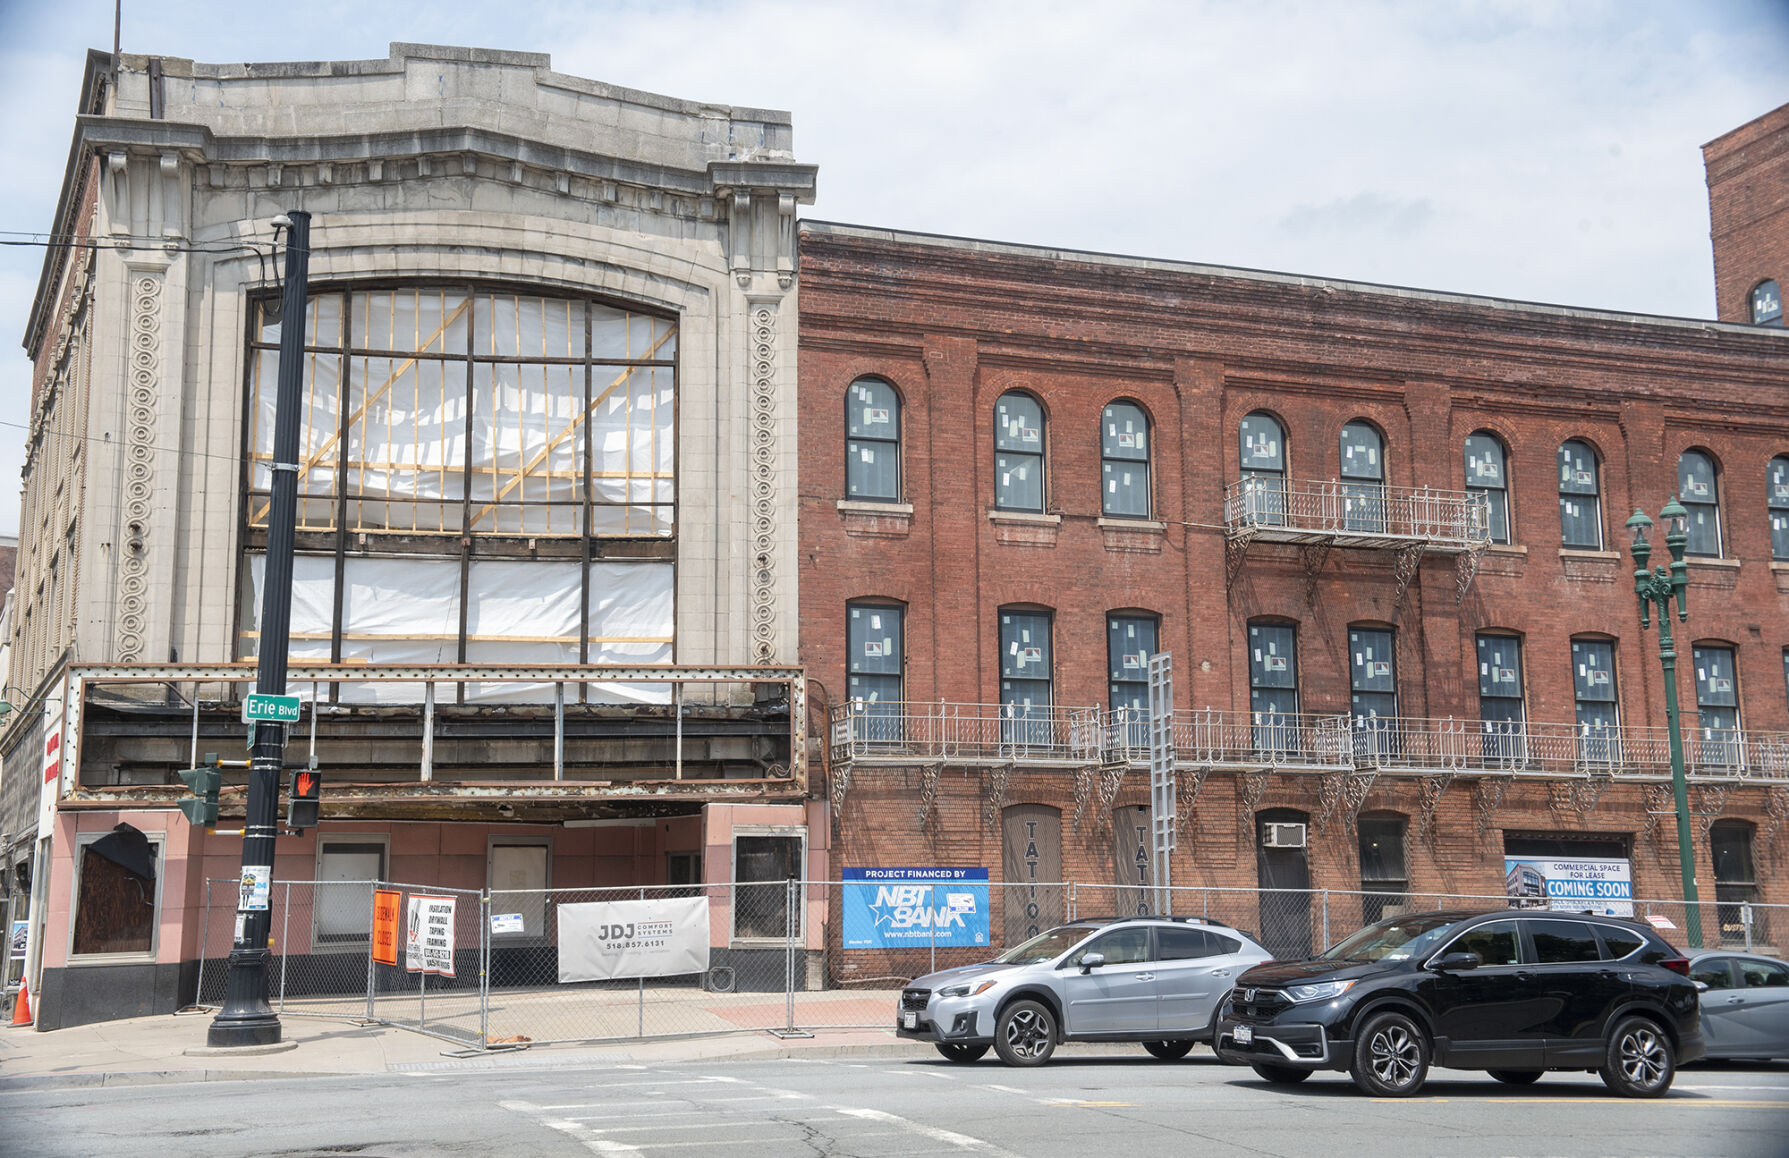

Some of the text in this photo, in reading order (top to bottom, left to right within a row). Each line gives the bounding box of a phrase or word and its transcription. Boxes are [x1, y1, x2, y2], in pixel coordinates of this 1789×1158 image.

[249, 699, 298, 717] Erie Blvd
[865, 870, 966, 878] PROJECT FINANCED BY
[1135, 826, 1149, 916] TATTO
[1553, 863, 1621, 872] COMMERCIAL SPACE
[1025, 820, 1040, 940] TATTOO
[1570, 871, 1584, 879] FOR
[1547, 881, 1630, 897] COMING SOON
[875, 885, 933, 907] NBT
[428, 915, 448, 925] DRYWALL
[890, 906, 966, 928] BANK
[429, 926, 445, 936] TAPING
[598, 923, 635, 941] JDJ
[1723, 923, 1745, 931] CUSTO
[606, 940, 664, 949] 518.857.6131
